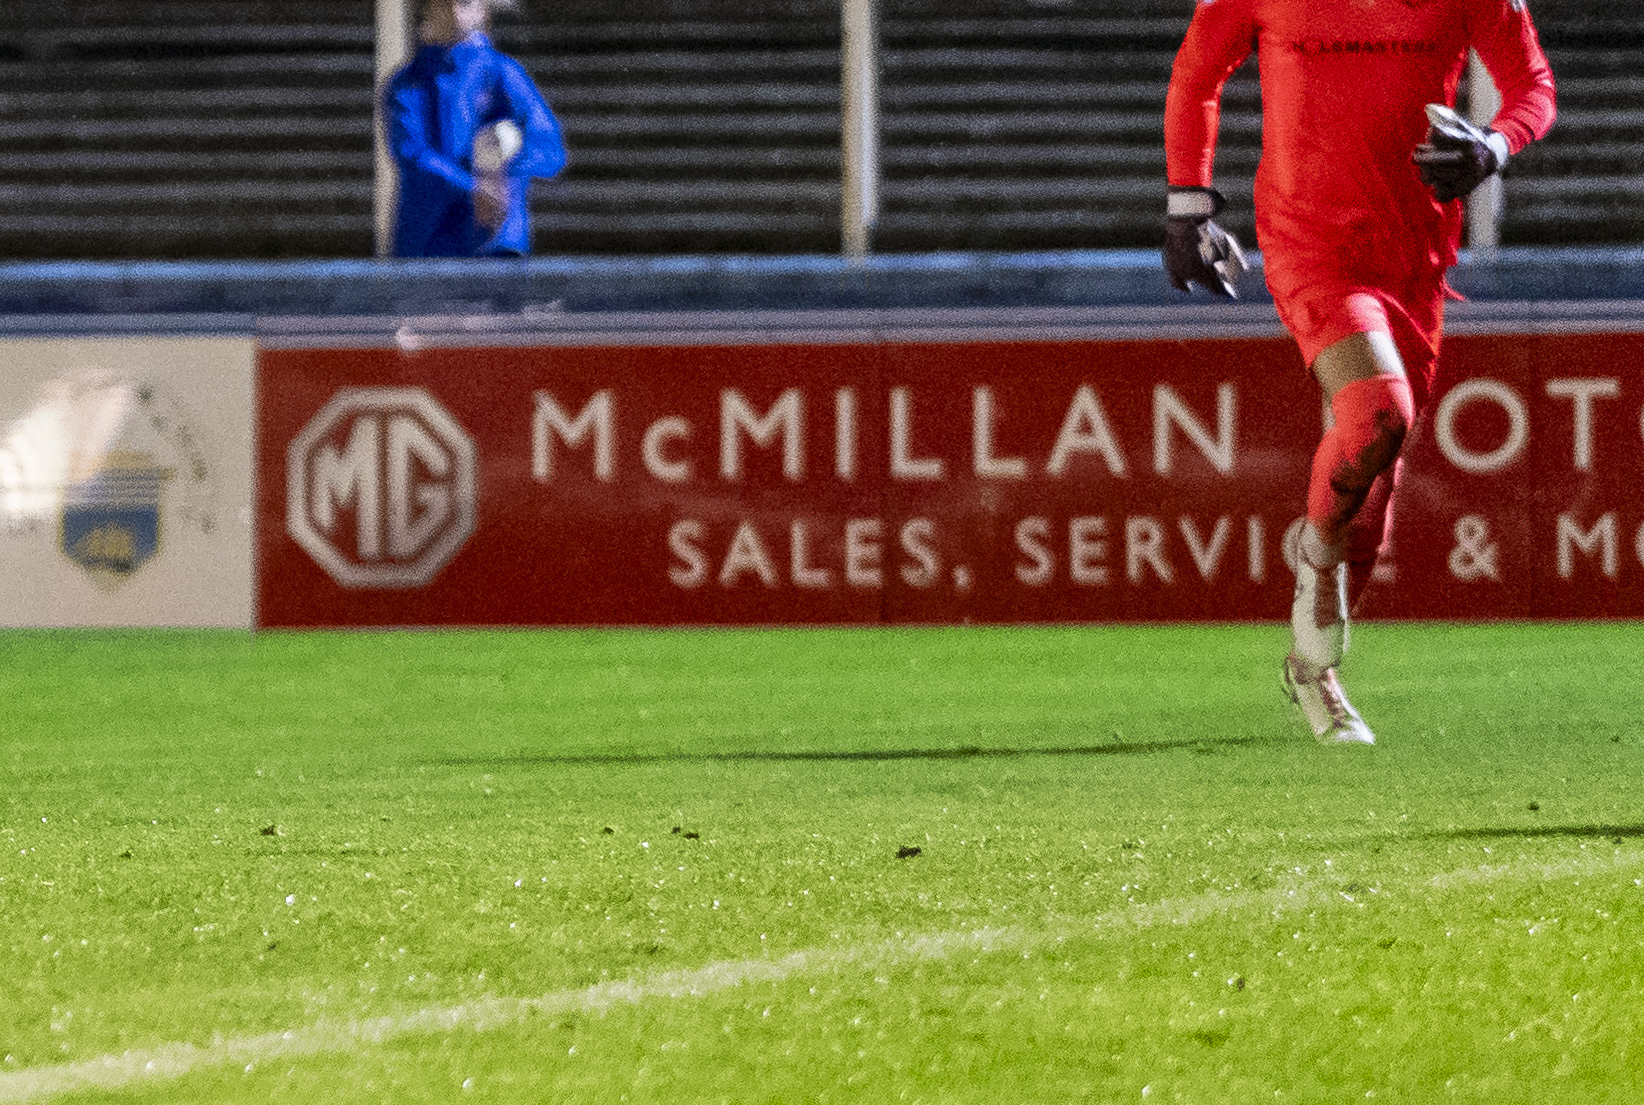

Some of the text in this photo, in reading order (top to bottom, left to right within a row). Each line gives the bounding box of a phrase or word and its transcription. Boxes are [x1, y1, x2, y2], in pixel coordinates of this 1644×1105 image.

[532, 383, 1239, 482] McMILLAN
[312, 414, 449, 560] MG
[1014, 513, 1397, 586] SERVI
[1448, 513, 1499, 583] &
[1558, 510, 1644, 581] M
